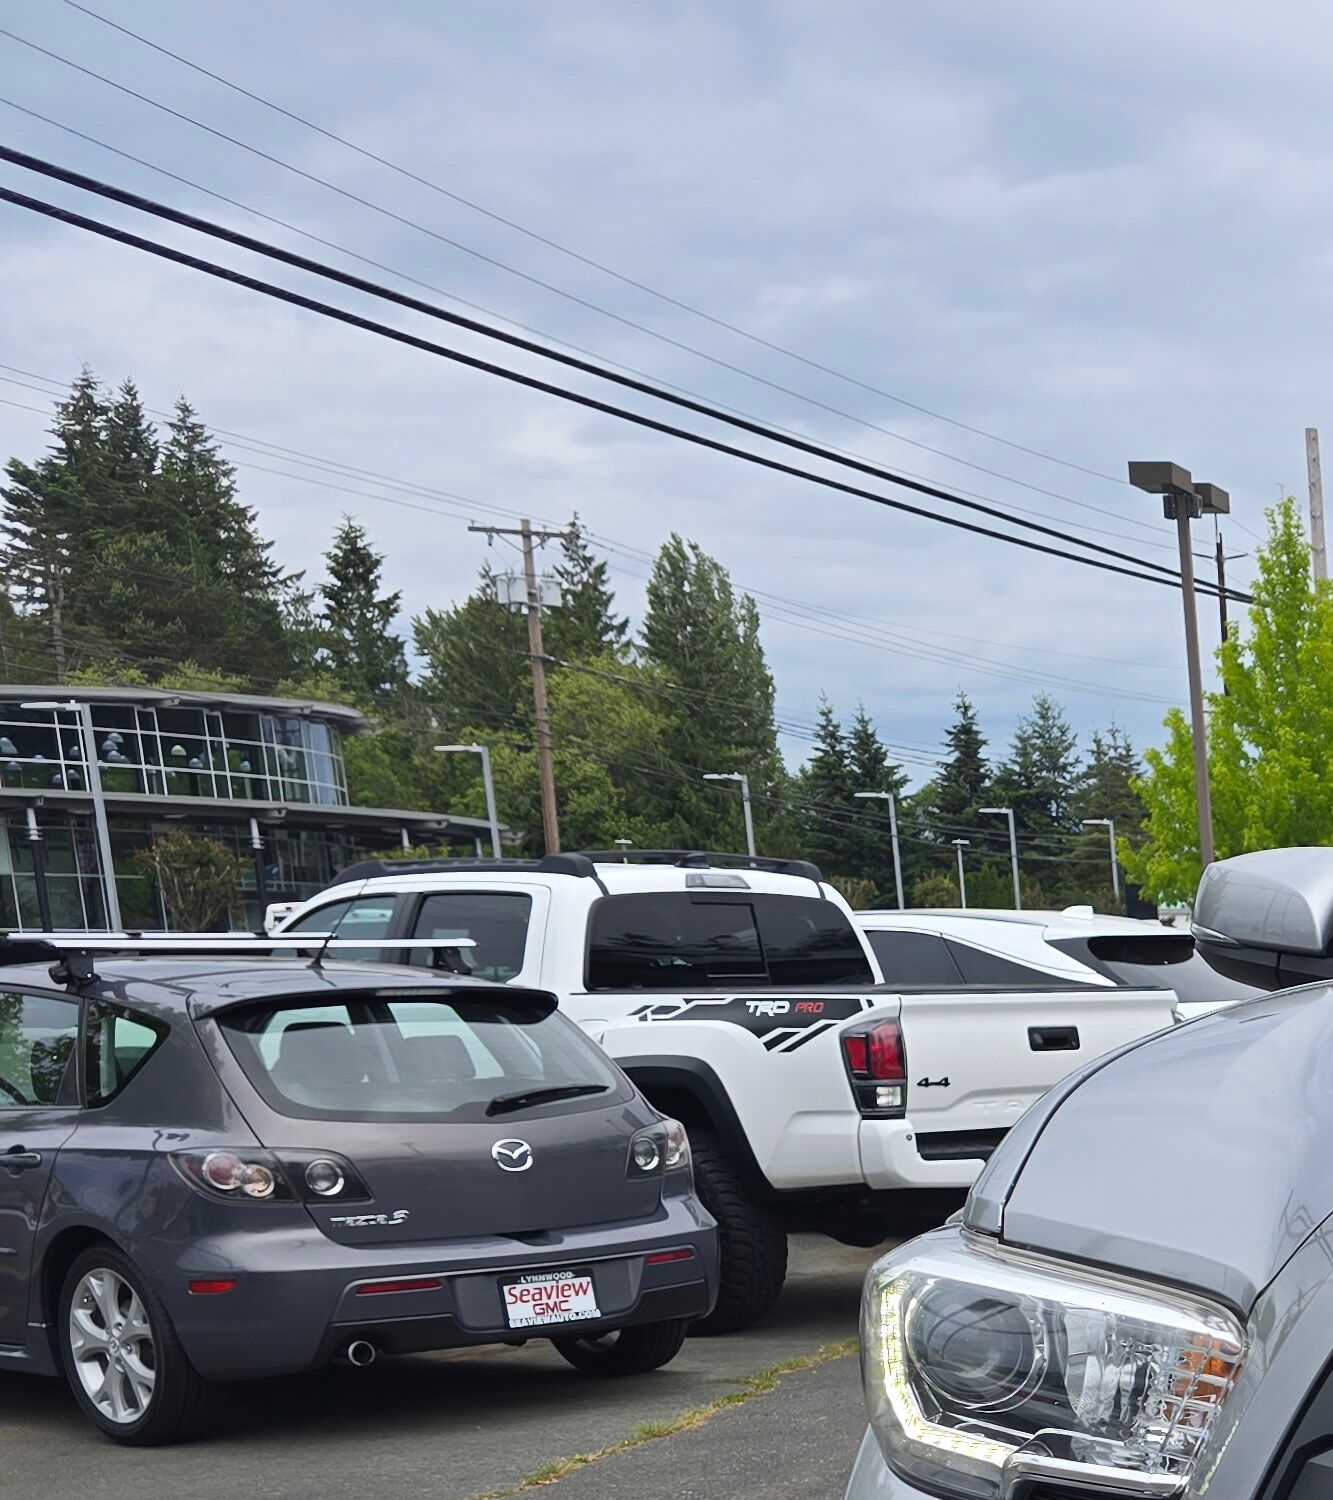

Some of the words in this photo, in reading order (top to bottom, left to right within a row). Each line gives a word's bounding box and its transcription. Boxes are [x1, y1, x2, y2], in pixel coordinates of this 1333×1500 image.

[745, 1001, 790, 1017] TRD
[795, 1002, 824, 1013] PRO
[520, 1271, 576, 1284] LYNNWOOD
[507, 1279, 591, 1305] Seaview
[533, 1300, 573, 1316] GMC
